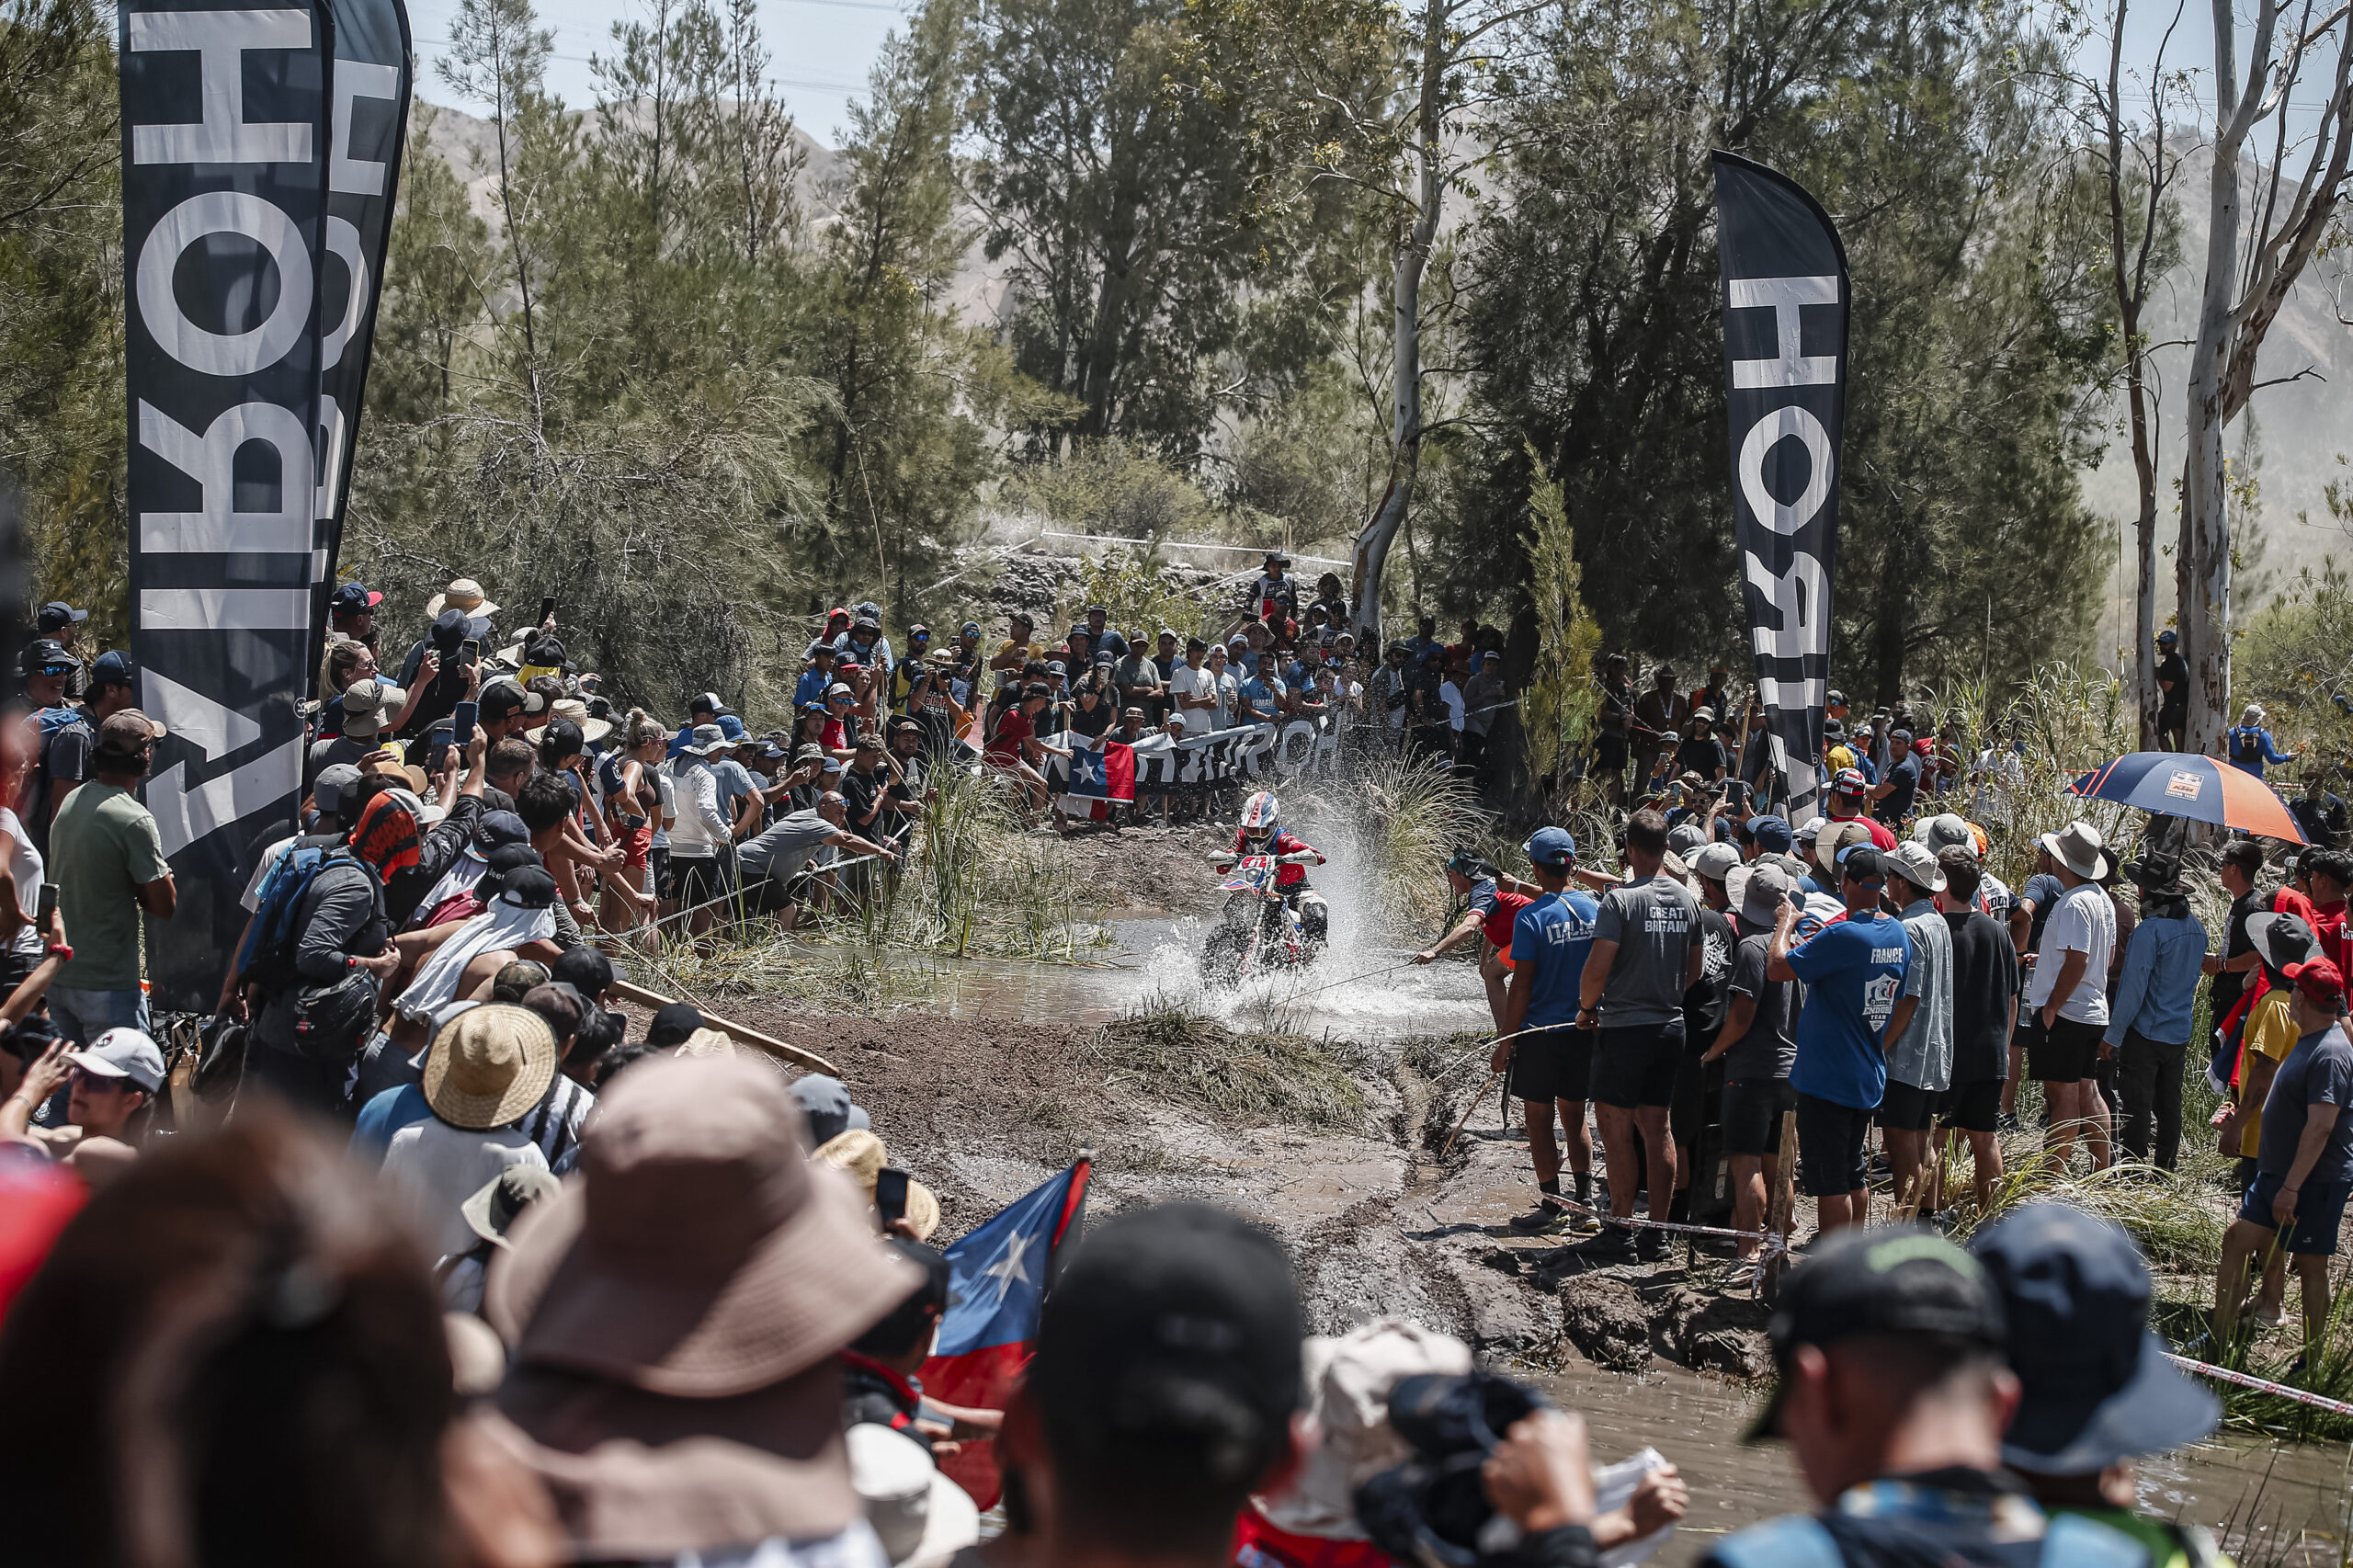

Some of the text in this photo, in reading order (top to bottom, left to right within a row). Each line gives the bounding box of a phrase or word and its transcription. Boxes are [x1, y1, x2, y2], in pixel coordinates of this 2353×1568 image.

[1649, 906, 1686, 919] GREAT
[1644, 920, 1688, 933] BRITAIN
[1870, 948, 1904, 963] FRANCE
